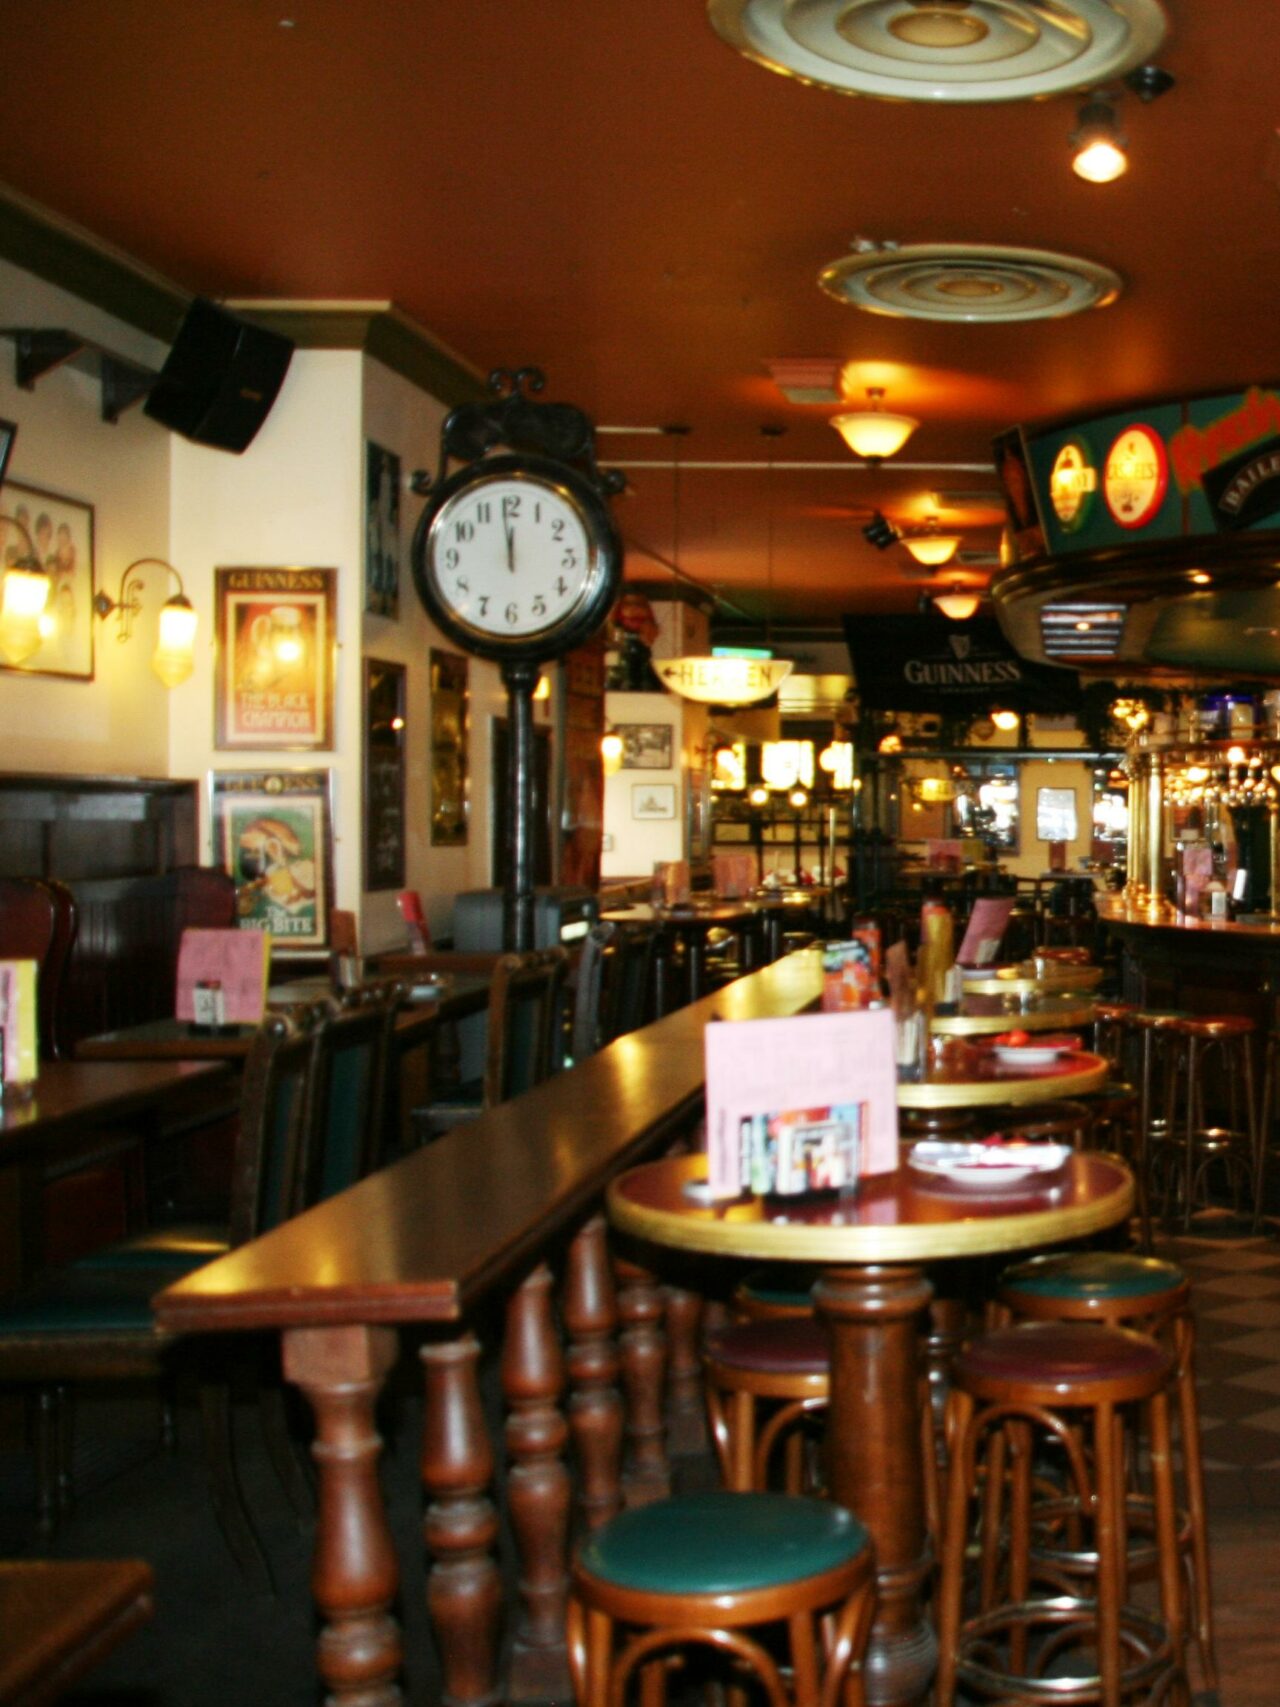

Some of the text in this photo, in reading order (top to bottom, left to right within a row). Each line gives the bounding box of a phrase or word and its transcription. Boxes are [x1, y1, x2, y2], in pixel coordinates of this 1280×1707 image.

[476, 502, 491, 524] 11
[454, 521, 475, 542] 10
[551, 519, 565, 542] 2
[446, 548, 460, 570] 9
[561, 548, 577, 569] 3
[228, 572, 323, 589] GUINNESS
[456, 575, 470, 593] 8
[556, 576, 568, 597] 4
[478, 596, 491, 617] 7
[505, 603, 518, 625] 6
[532, 595, 546, 617] 5
[680, 663, 772, 687] HEEN
[904, 660, 1021, 684] GUINNESS
[225, 774, 321, 791] GUIESS
[239, 917, 313, 933] BIG BITE
